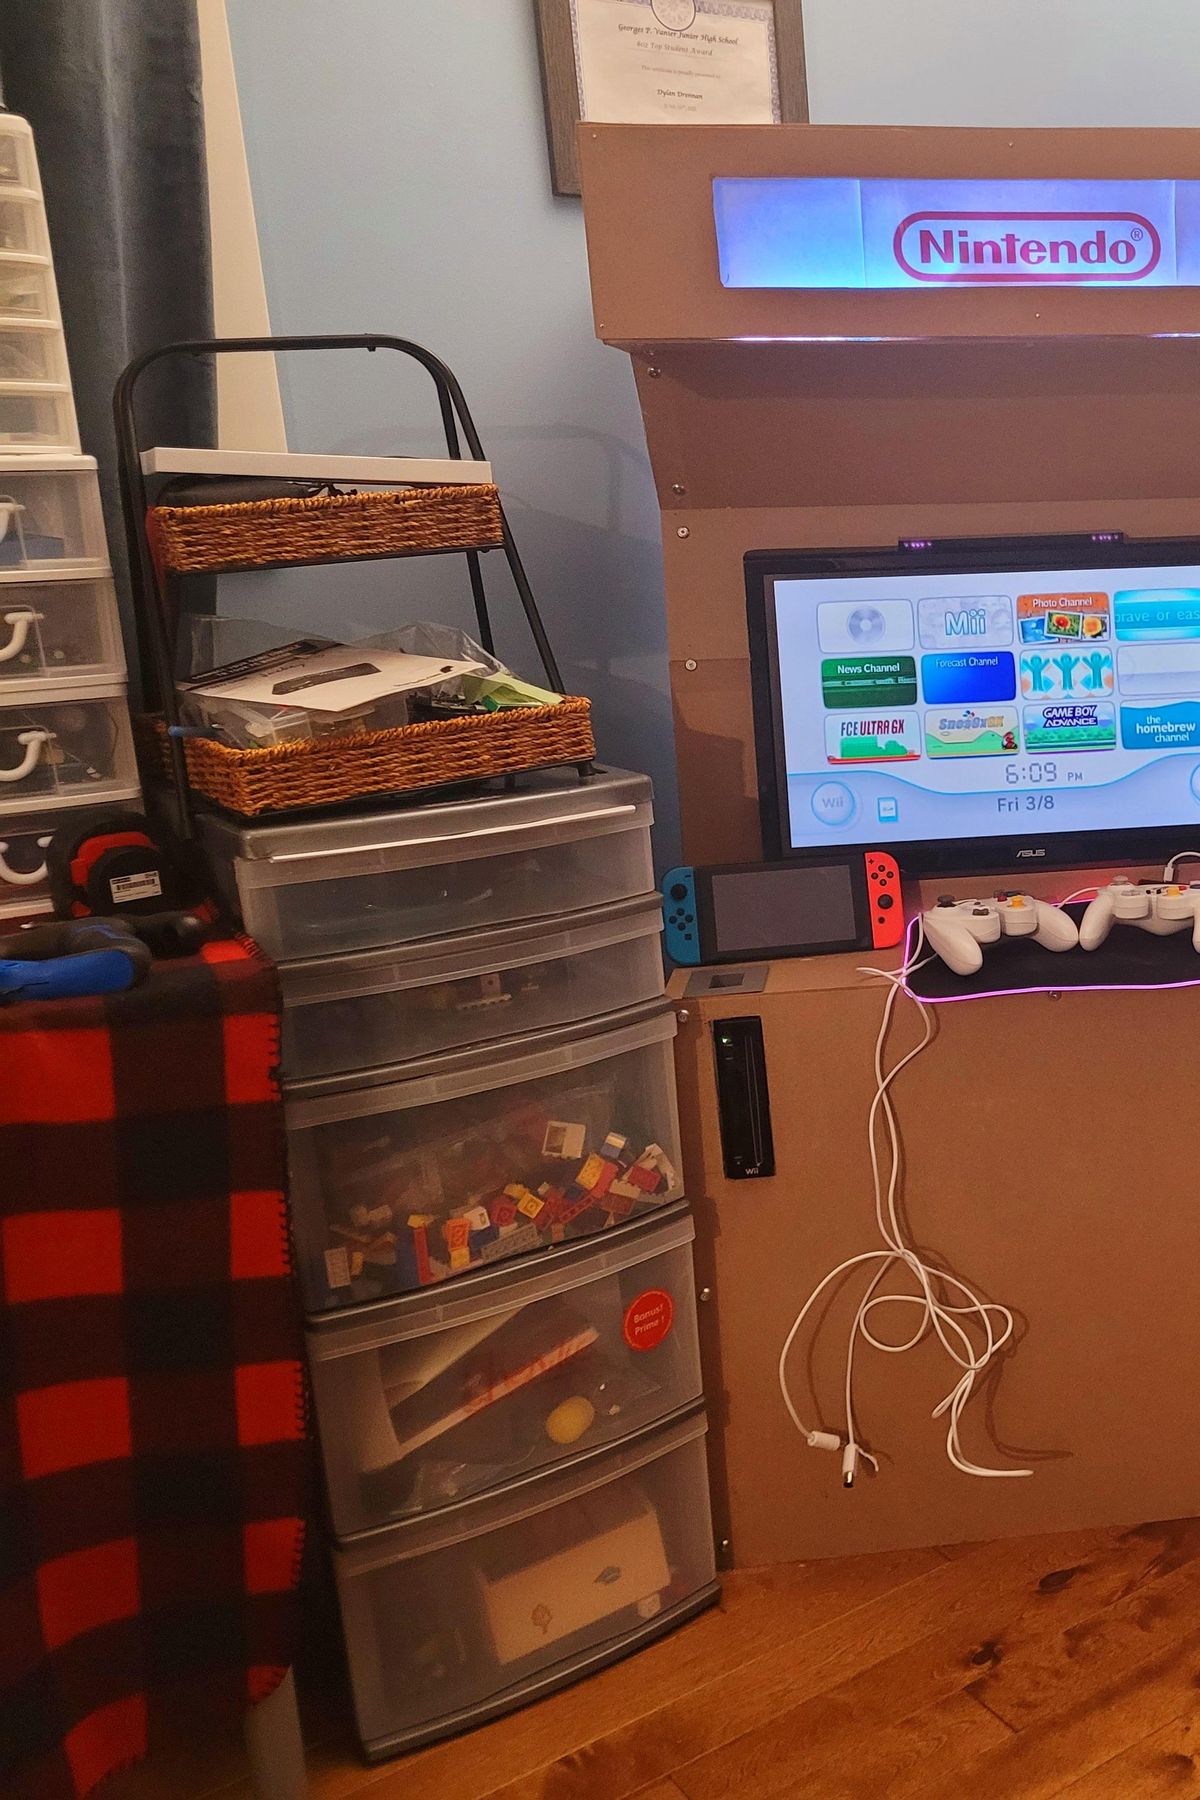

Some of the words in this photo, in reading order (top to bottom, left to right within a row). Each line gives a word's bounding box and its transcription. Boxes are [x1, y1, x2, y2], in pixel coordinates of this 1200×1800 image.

[718, 37, 738, 45] School
[919, 229, 1136, 264] Nintendo
[1032, 598, 1057, 608] Photo
[1059, 596, 1092, 607] Channel
[1156, 611, 1170, 621] or
[944, 609, 986, 636] Mii
[837, 664, 862, 674] News
[863, 662, 900, 673] Channel
[935, 658, 966, 668] Forecast
[969, 656, 998, 666] Channel
[1043, 707, 1073, 718] GAME
[1074, 706, 1095, 717] BOY
[1045, 717, 1097, 727] ADVANCE
[1146, 715, 1161, 724] the
[840, 721, 858, 737] FCE
[860, 720, 890, 736] ULTRA
[891, 719, 904, 734] GX
[1136, 722, 1196, 734] homebrew
[1155, 732, 1190, 743] channel
[1006, 762, 1057, 784] 6:09
[1067, 772, 1083, 782] PM
[822, 797, 844, 809] Wii
[997, 797, 1019, 812] Fri
[1026, 795, 1055, 811] 3/8
[1016, 849, 1046, 858] ASUS
[745, 1167, 759, 1175] Wii
